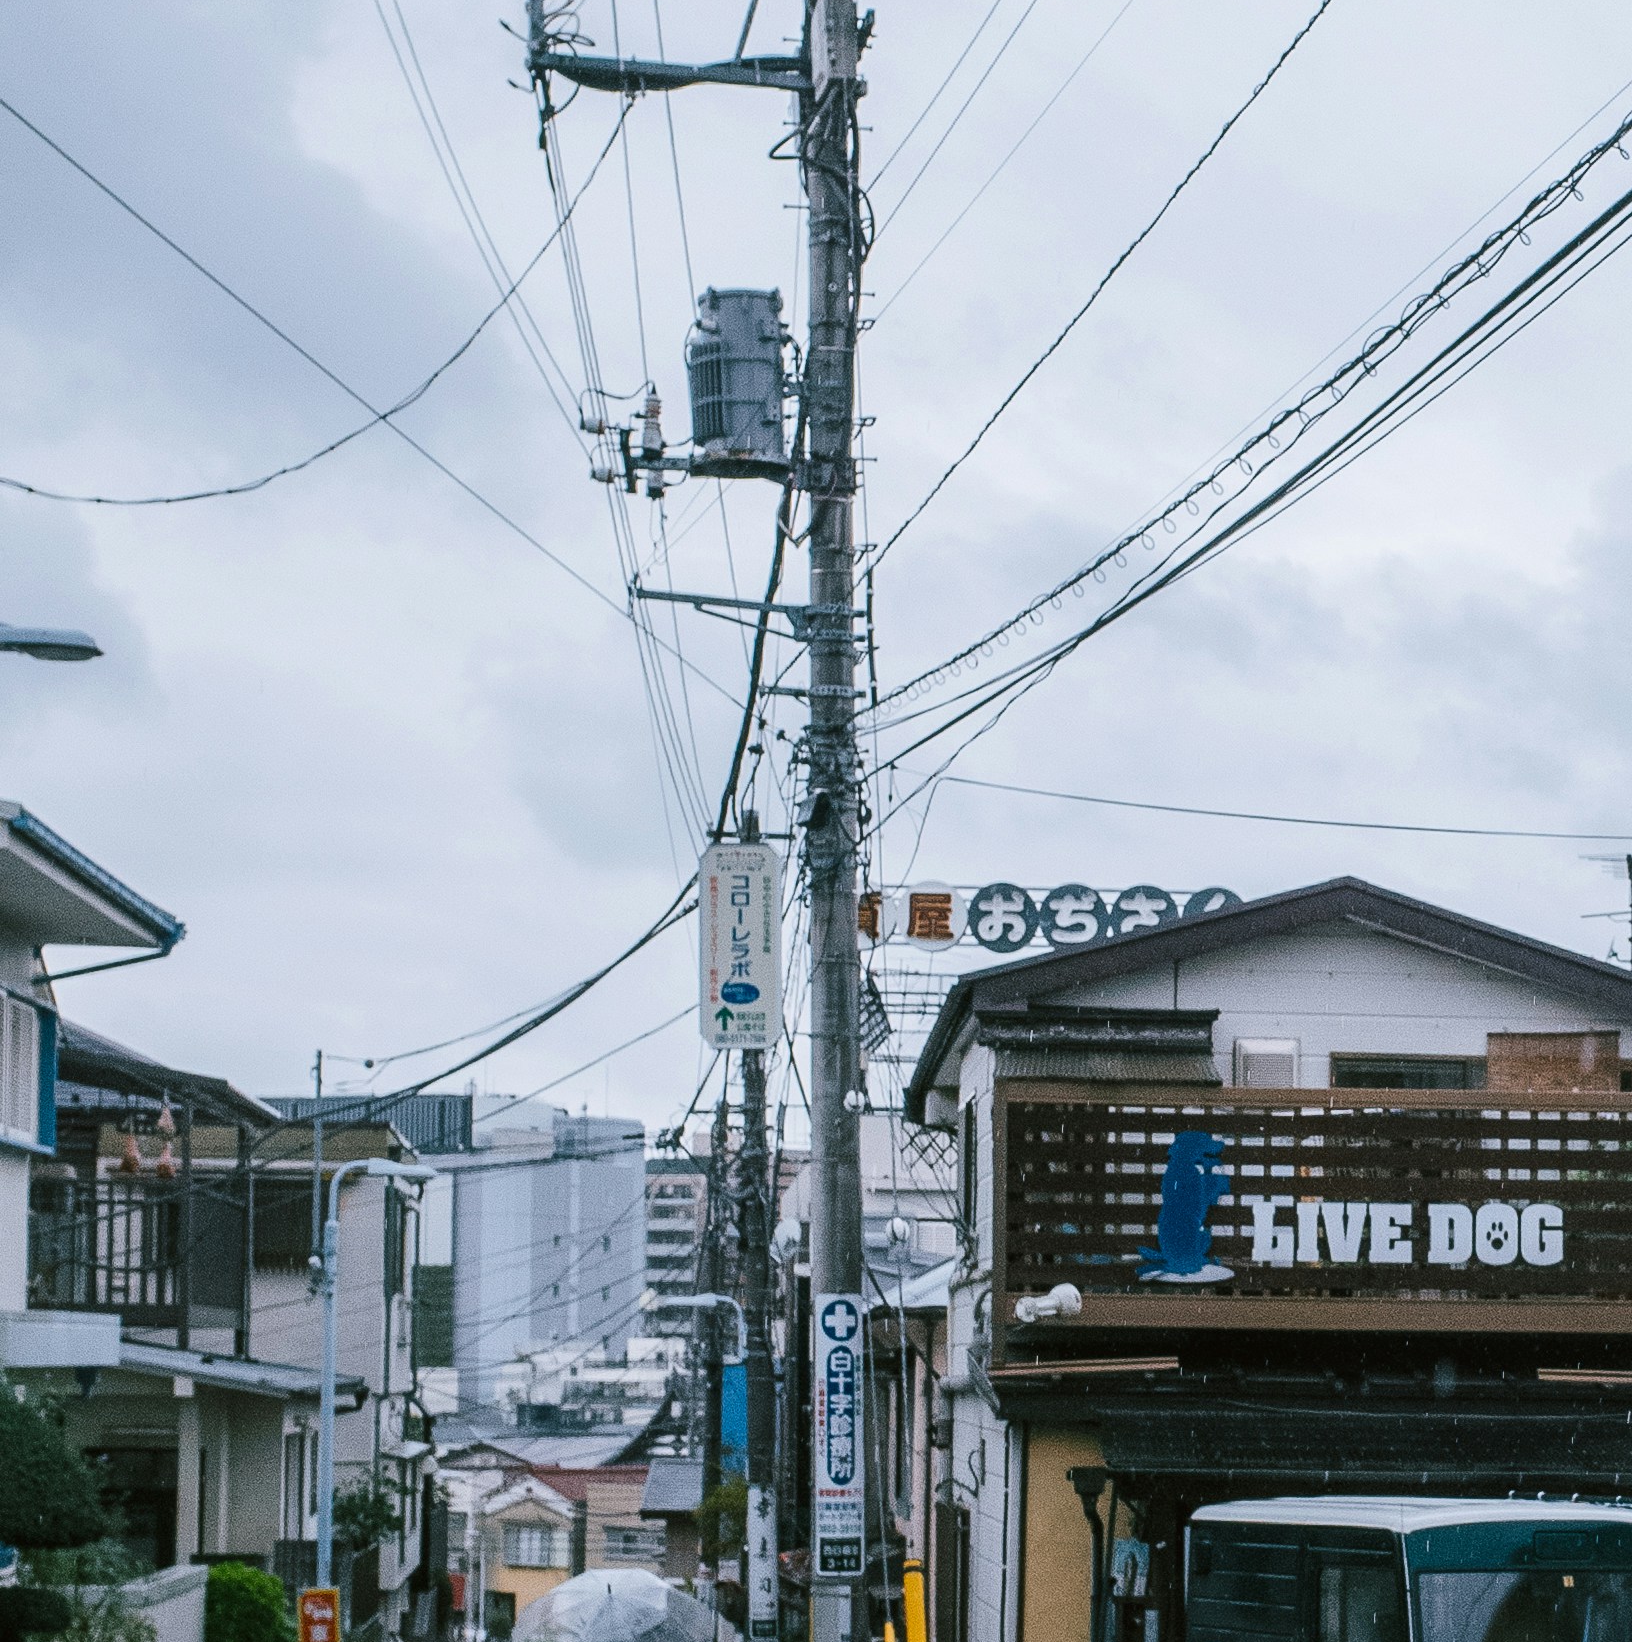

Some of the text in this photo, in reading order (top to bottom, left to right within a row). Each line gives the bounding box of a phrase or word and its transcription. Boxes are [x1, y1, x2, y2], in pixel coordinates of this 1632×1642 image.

[731, 875, 751, 977] コローレラボ
[858, 891, 1226, 944] 質屋おぢさ
[1252, 1202, 1564, 1266] LIVE DOG
[829, 1351, 853, 1478] 白十字診療所
